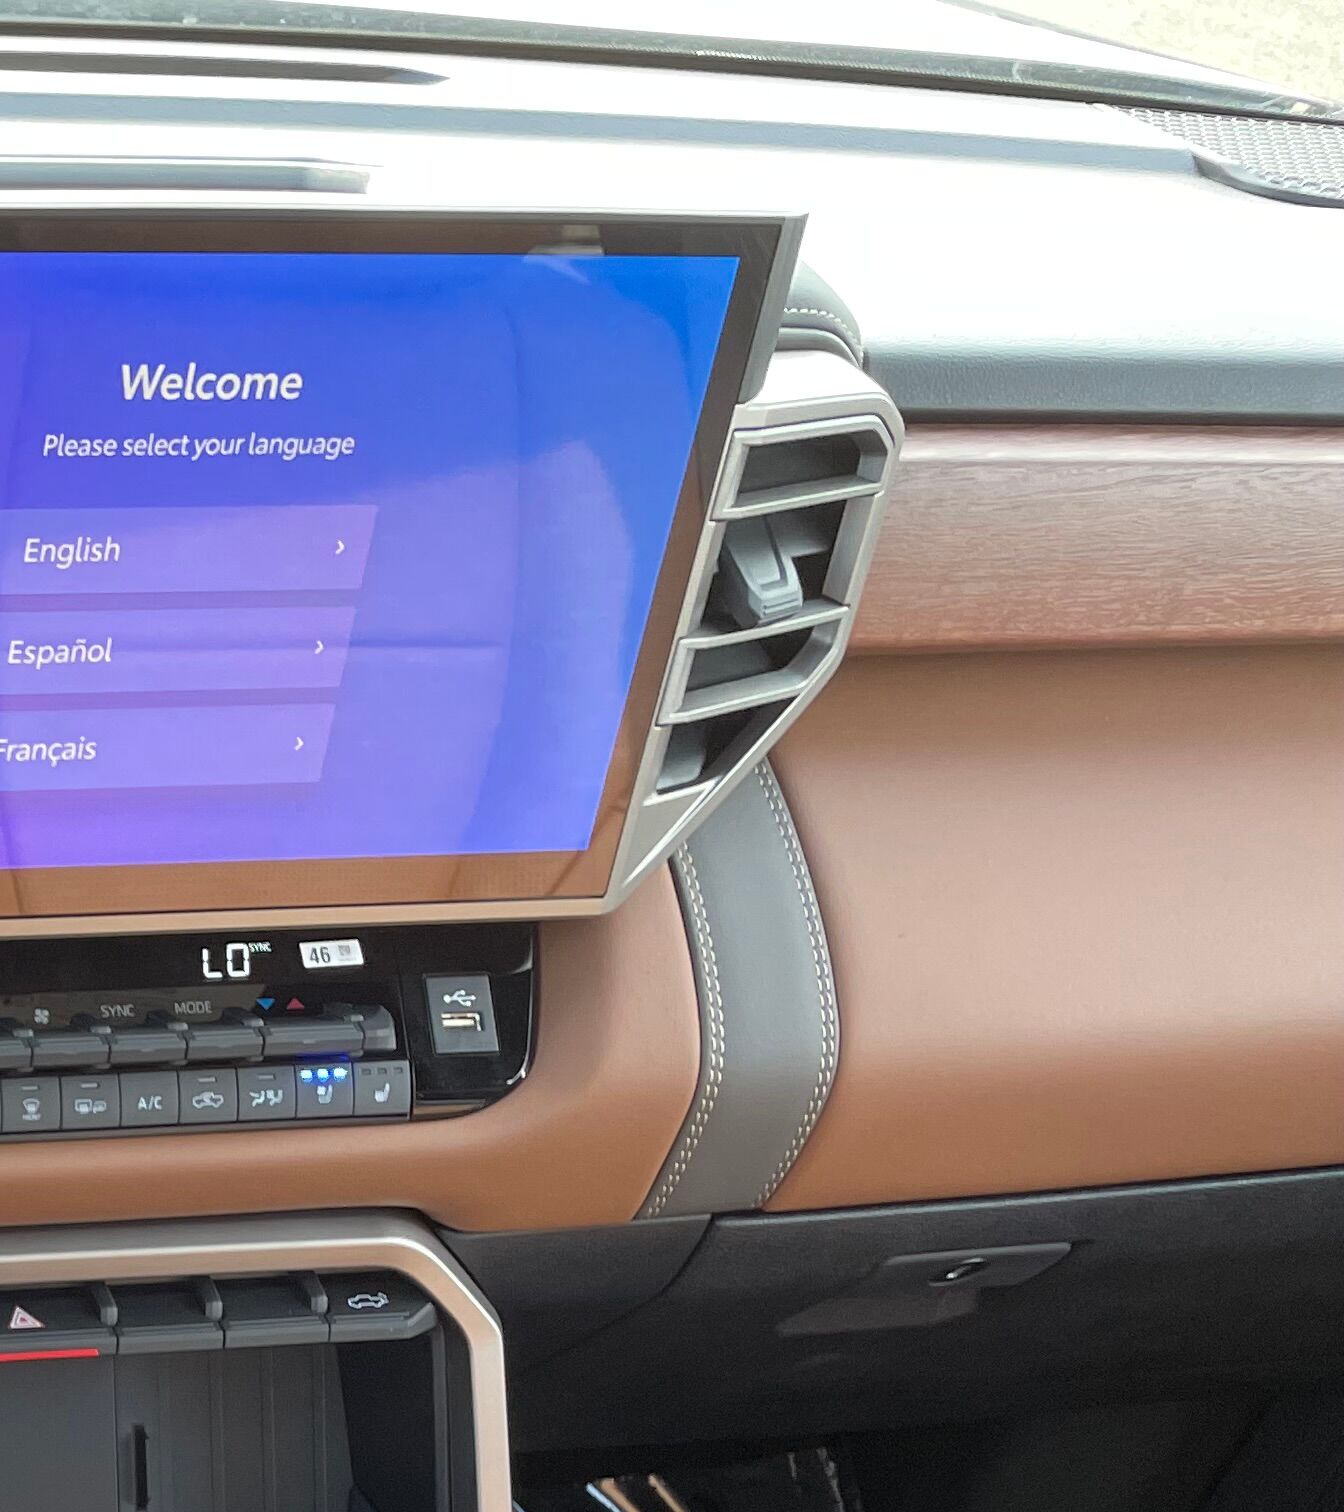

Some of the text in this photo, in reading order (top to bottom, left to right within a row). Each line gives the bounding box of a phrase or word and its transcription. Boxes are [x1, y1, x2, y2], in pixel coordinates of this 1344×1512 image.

[120, 362, 304, 401] Welcome
[42, 432, 356, 462] Please select your language
[23, 537, 121, 570] English
[7, 638, 113, 671] Español
[202, 942, 250, 979] LO
[309, 946, 331, 964] 46
[100, 1004, 136, 1018] SYNC
[174, 1000, 213, 1015] MODE
[137, 1095, 163, 1111] A/C
